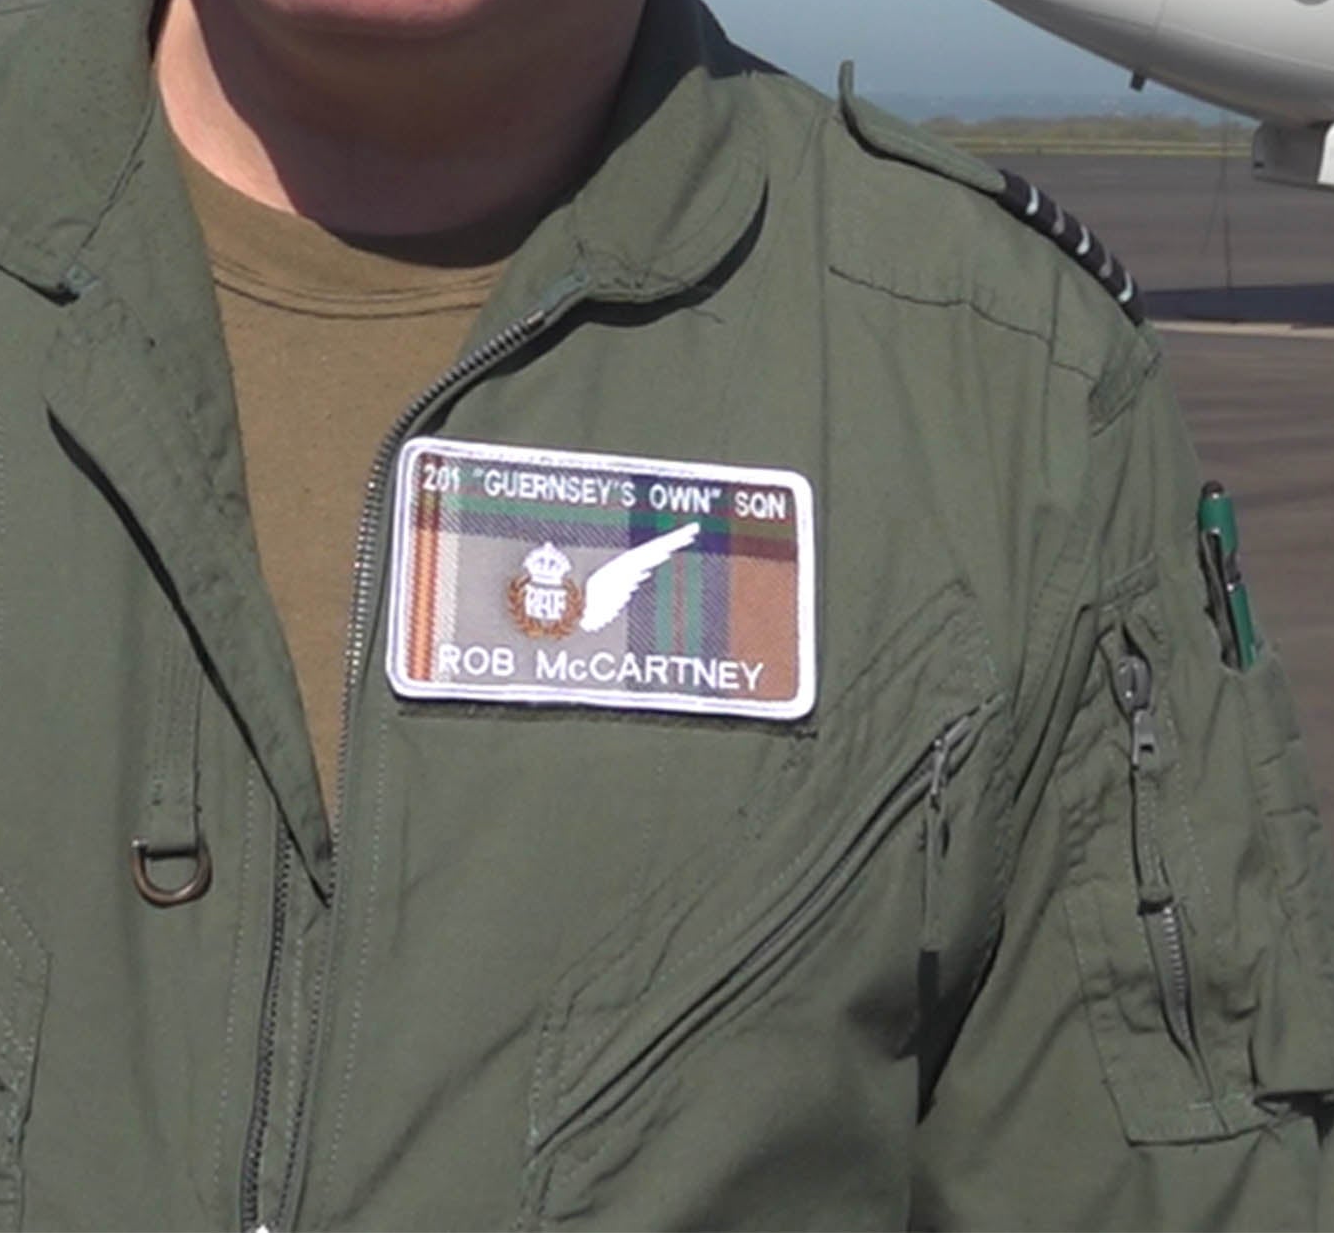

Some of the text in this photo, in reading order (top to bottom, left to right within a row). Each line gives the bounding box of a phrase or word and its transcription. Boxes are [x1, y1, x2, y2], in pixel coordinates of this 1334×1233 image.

[422, 463, 786, 520] 201 "GUERNSEY'S OWN" SQN
[437, 645, 764, 691] ROB McCARTNEY
